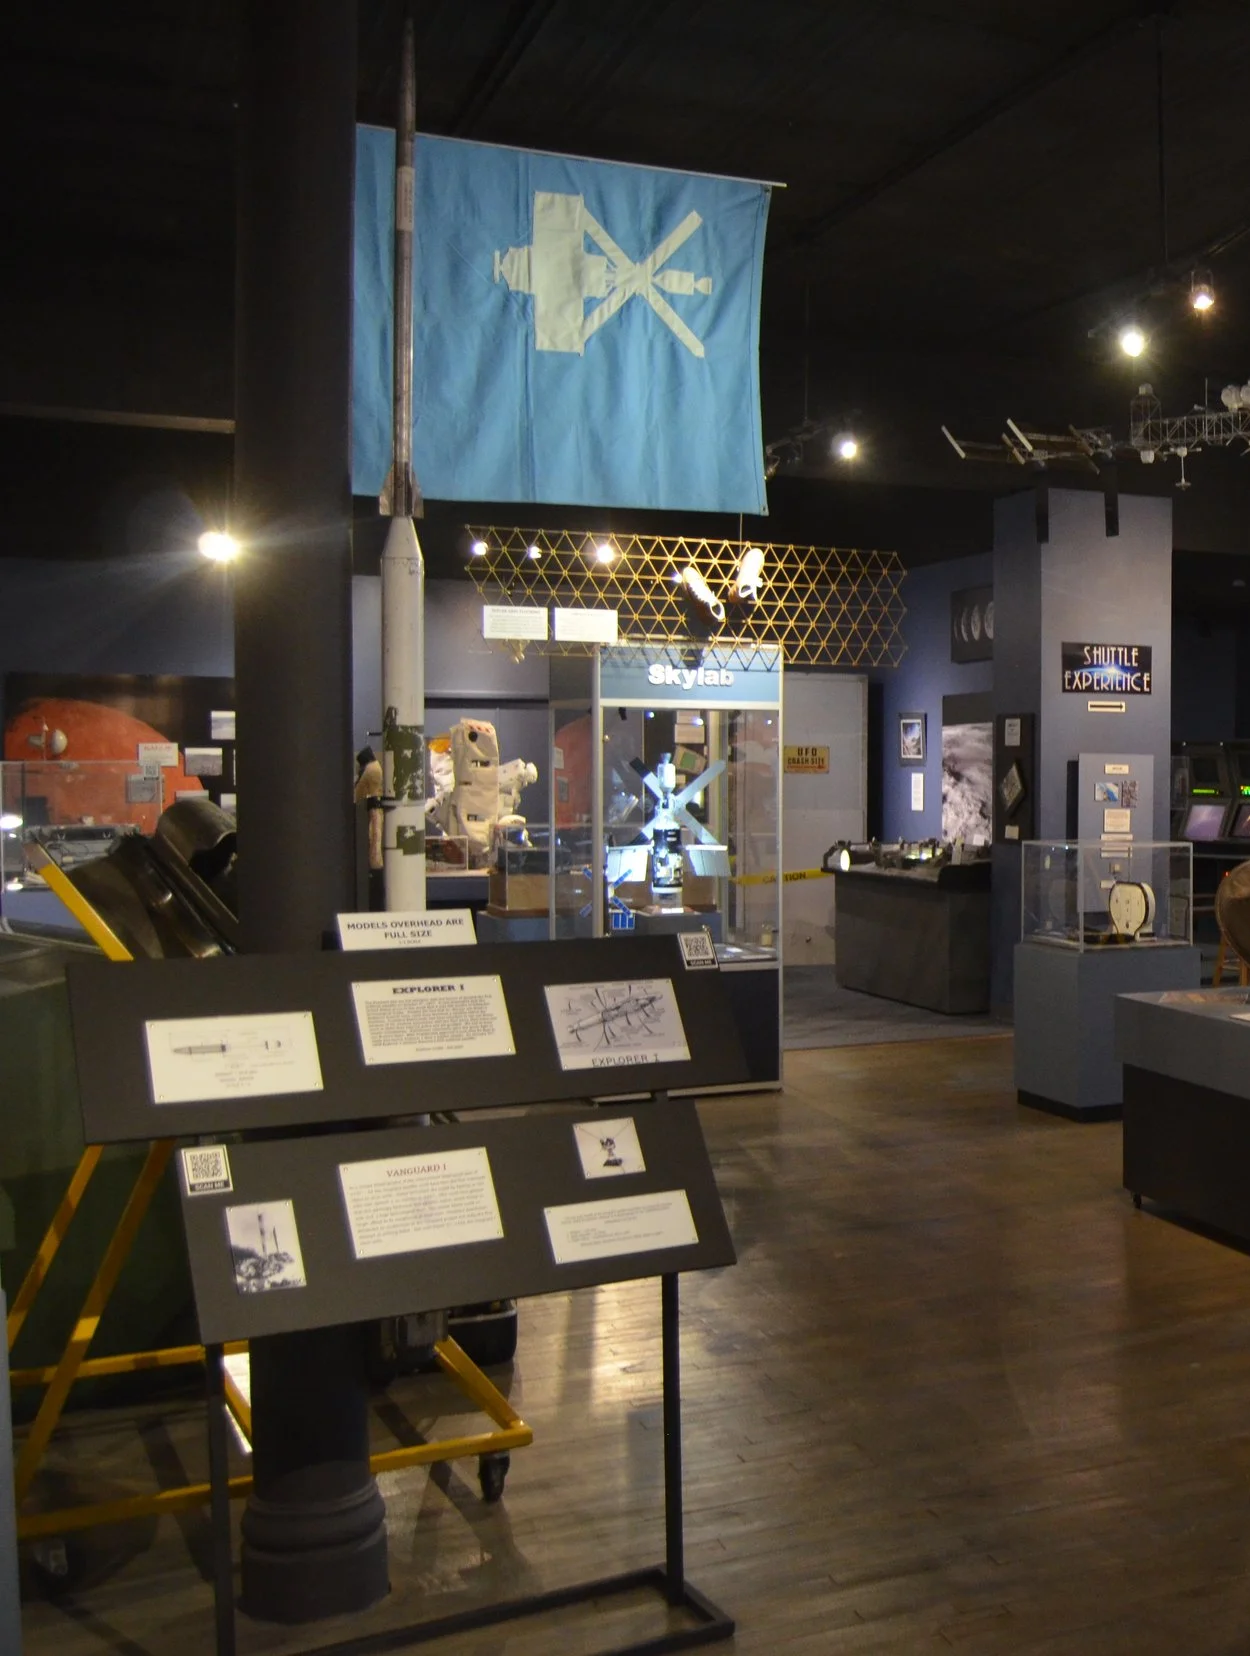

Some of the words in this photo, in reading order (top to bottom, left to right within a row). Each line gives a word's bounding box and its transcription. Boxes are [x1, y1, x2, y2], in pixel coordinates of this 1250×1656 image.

[1083, 646, 1139, 667] SHUTTLE
[648, 664, 735, 690] Skylab
[1064, 670, 1151, 692] EXPERIENCE
[787, 757, 809, 765] CRASH
[762, 871, 807, 884] CATION
[347, 921, 388, 930] MODELS
[390, 919, 443, 929] OVERHEAD
[445, 918, 464, 926] ARE
[384, 931, 408, 939] FULL
[410, 930, 433, 938] SIZE
[392, 984, 456, 995] EXPLORER
[591, 1054, 648, 1067] EXPLORER
[386, 1165, 441, 1177] VANGUARD
[195, 1182, 213, 1191] SCAN
[214, 1181, 225, 1189] ME
